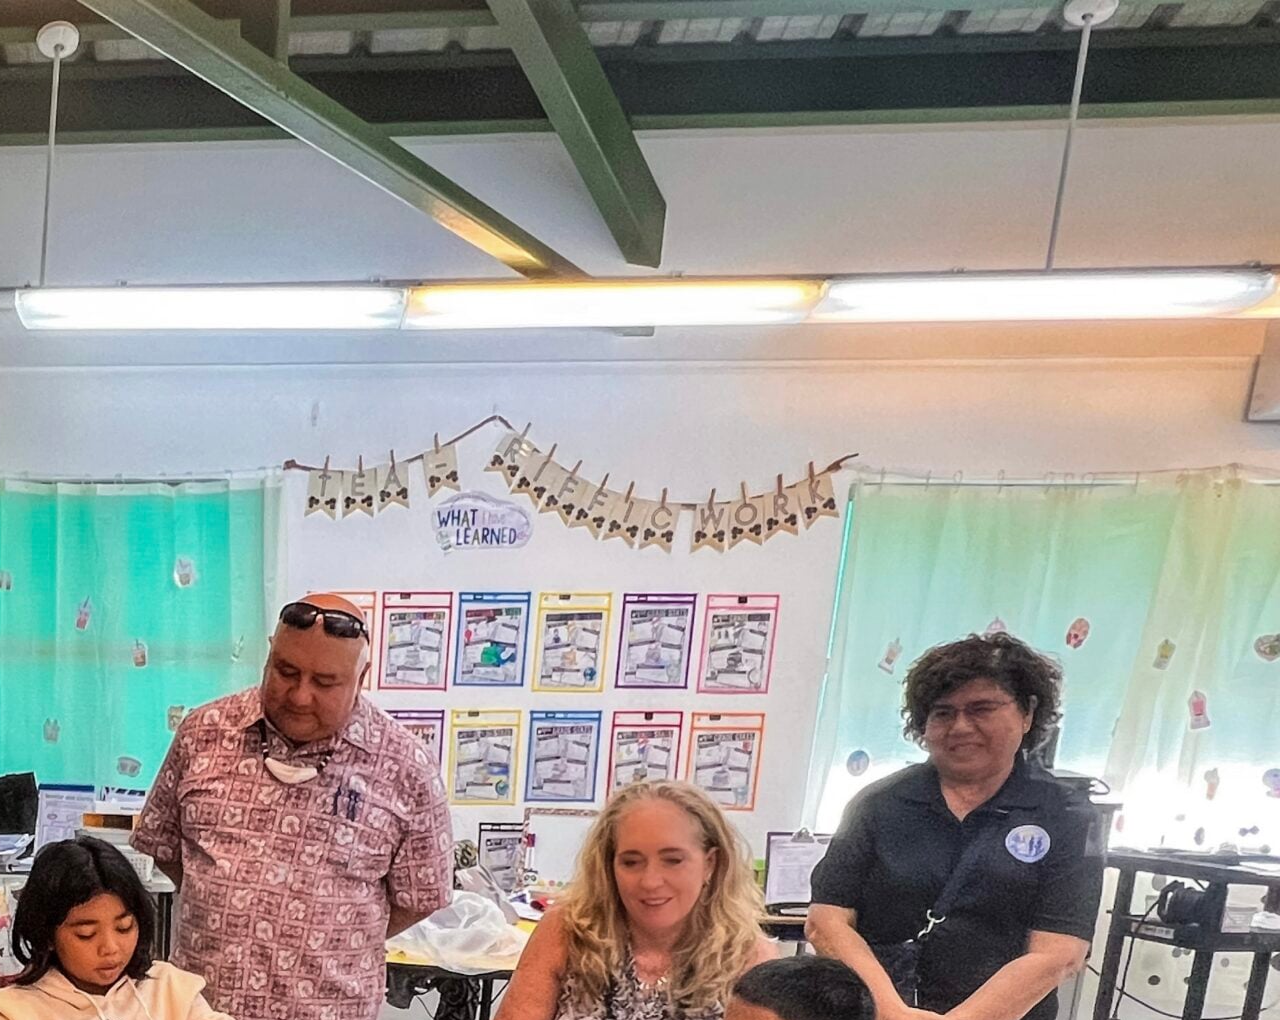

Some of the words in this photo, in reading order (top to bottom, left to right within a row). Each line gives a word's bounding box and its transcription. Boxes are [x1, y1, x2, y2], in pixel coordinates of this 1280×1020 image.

[700, 479, 825, 531] WORK
[437, 509, 478, 528] WHAT
[456, 527, 517, 545] LEARNED
